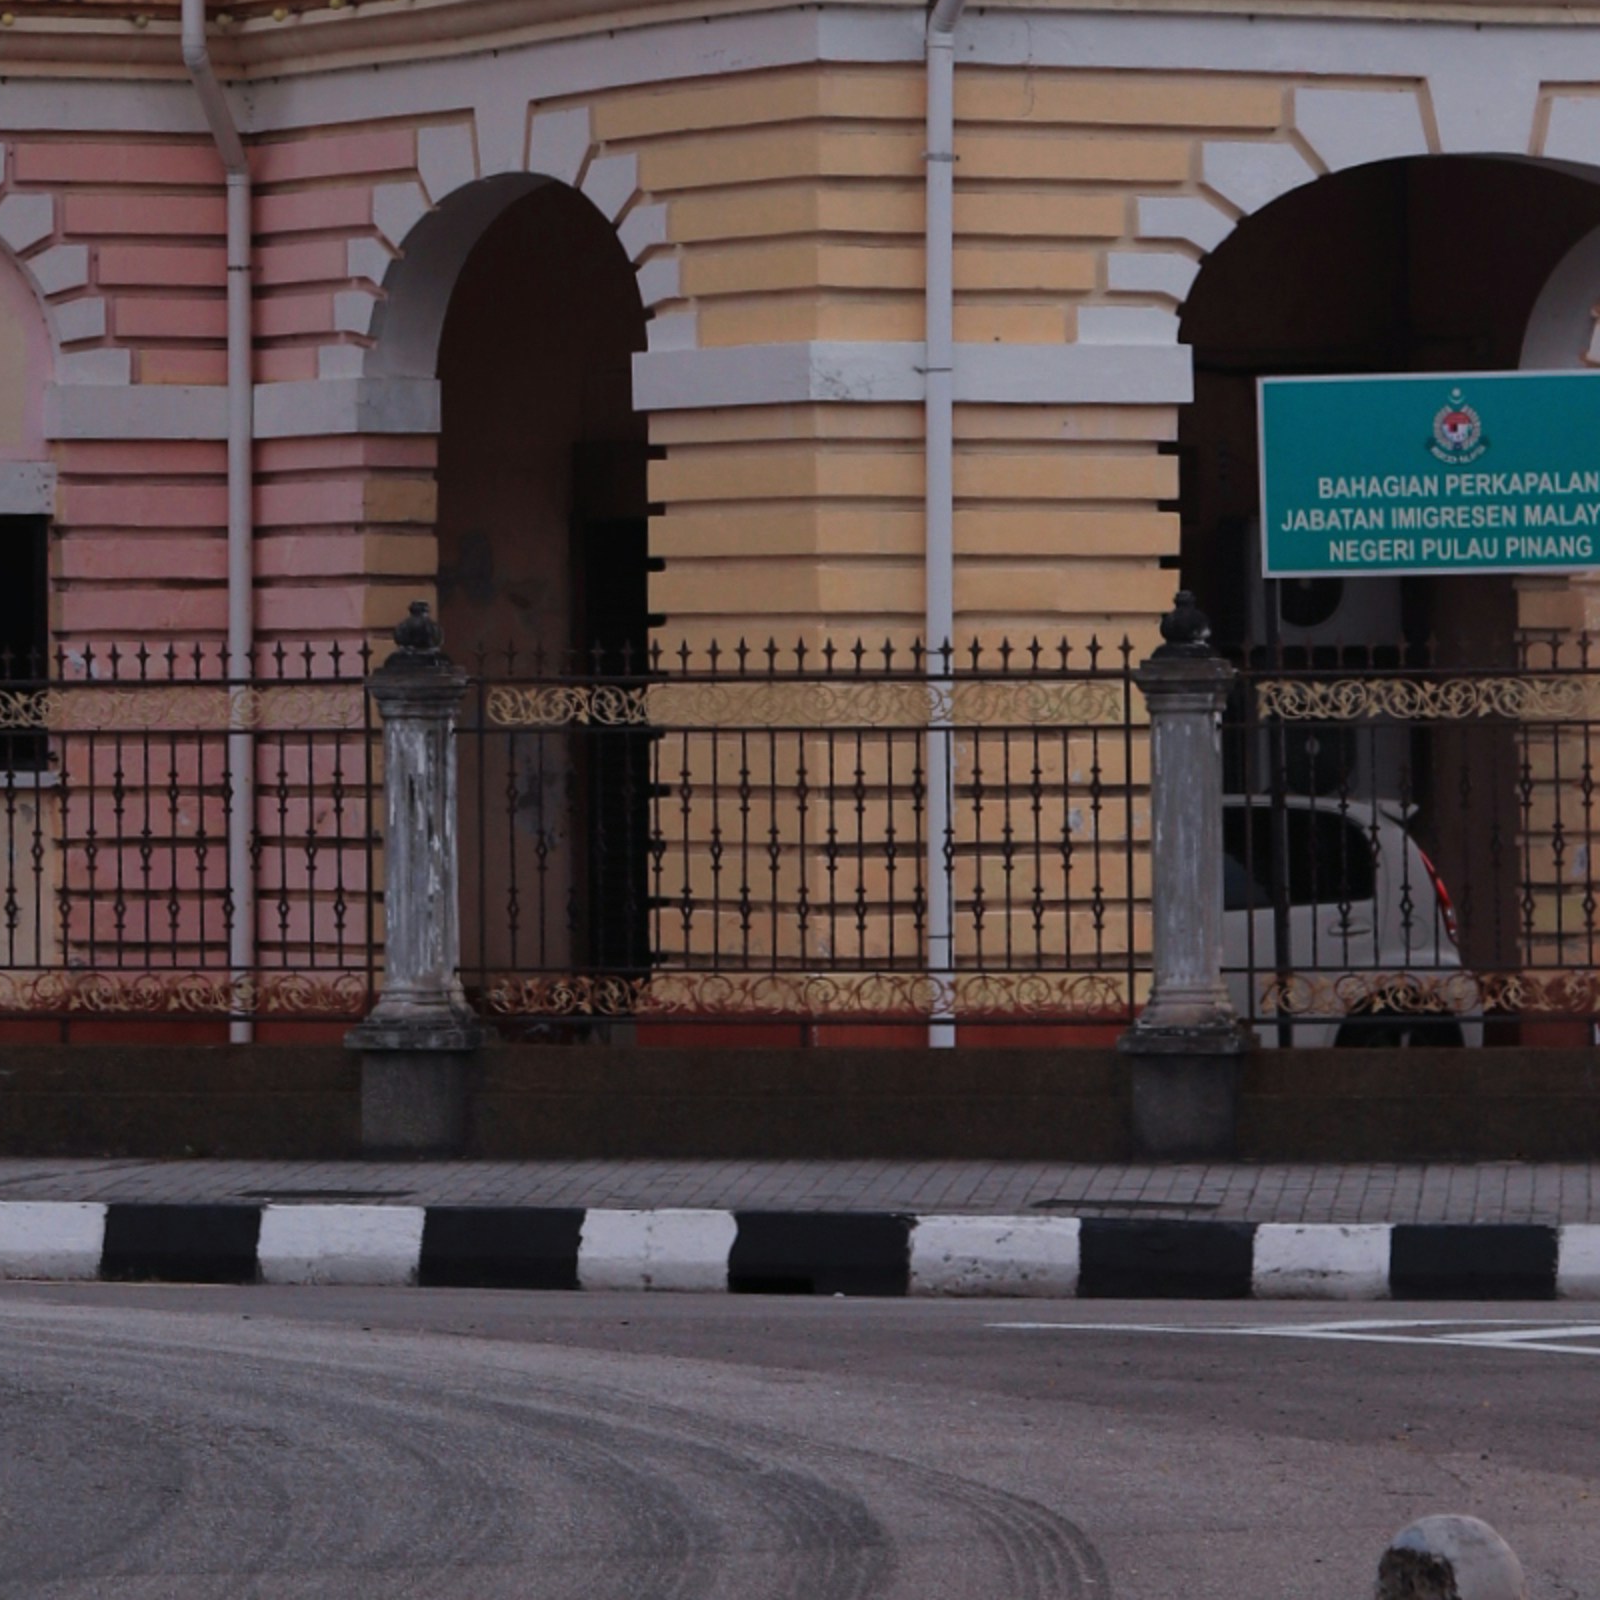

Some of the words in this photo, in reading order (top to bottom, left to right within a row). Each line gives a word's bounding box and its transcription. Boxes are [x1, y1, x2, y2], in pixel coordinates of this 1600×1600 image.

[1319, 476, 1439, 499] BAHAGIAN
[1446, 471, 1600, 496] PERKAPALAN
[1281, 508, 1384, 532] JABATAN
[1392, 505, 1517, 530] IMIGRESEN
[1330, 539, 1415, 562] NEGERI
[1422, 537, 1499, 560] PULAU
[1505, 535, 1593, 558] PINANG
